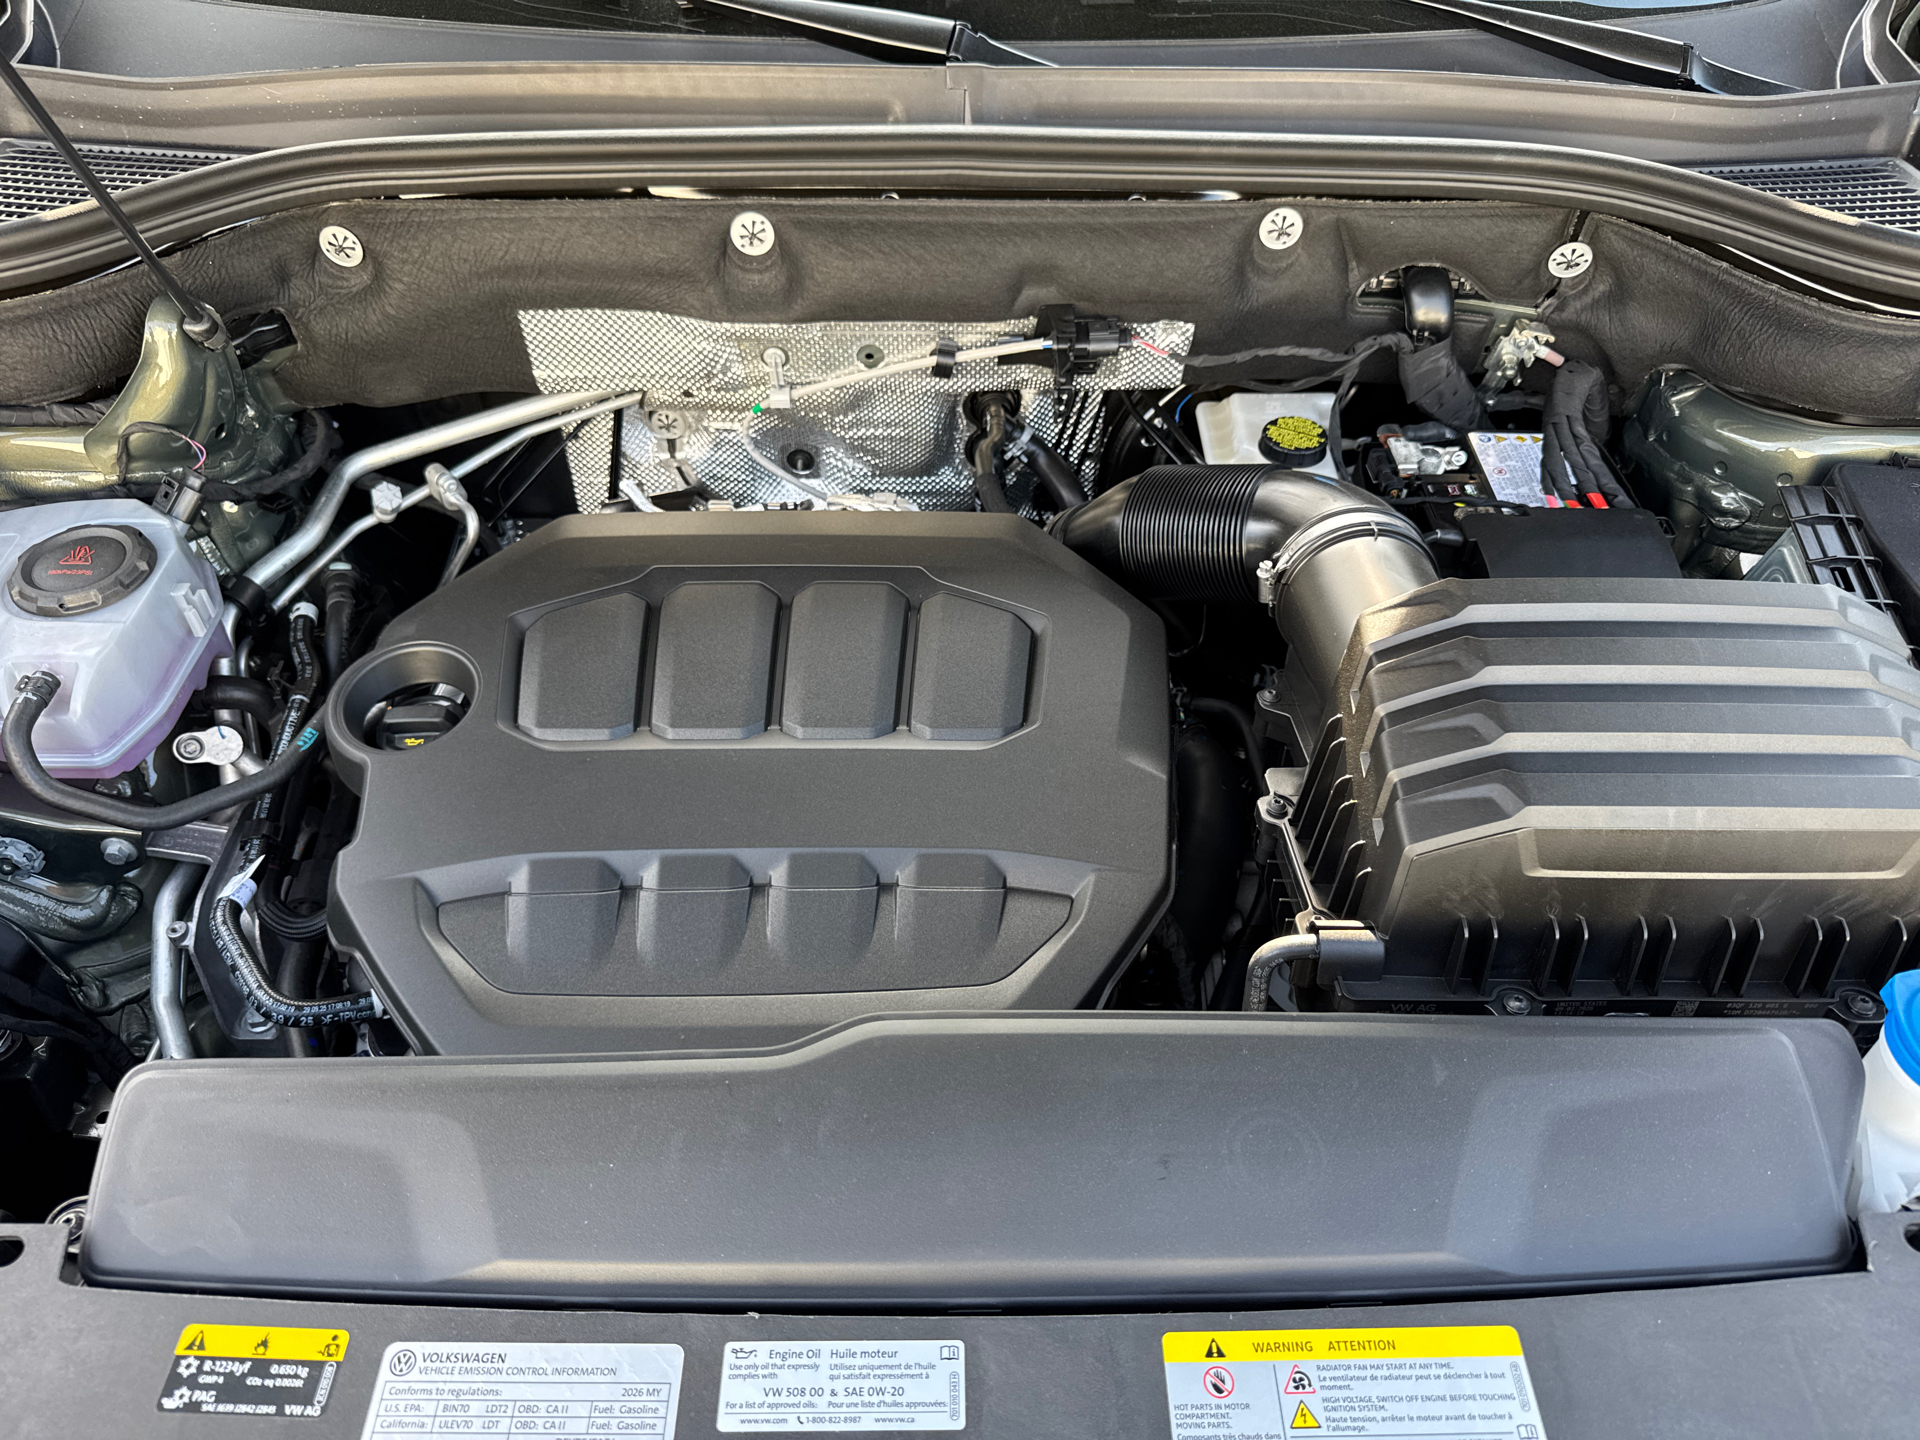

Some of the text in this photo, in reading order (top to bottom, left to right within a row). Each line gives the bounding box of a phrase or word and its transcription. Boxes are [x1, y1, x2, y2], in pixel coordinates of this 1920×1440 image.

[1391, 1003, 1437, 1012] VW AG
[271, 1013, 285, 1024] 39
[300, 1016, 314, 1026] 25
[1252, 1339, 1396, 1353] WARNING ATTENTION
[422, 1352, 507, 1364] VOLKSWAGEN
[768, 1349, 821, 1362] Engine Oil
[830, 1349, 898, 1359] Huile moteur
[202, 1360, 252, 1377] R-1234yf
[297, 1365, 310, 1379] kg
[419, 1366, 617, 1377] VEHICLE EMISSION CONTROL INFORMATION
[729, 1362, 820, 1372] Use only oil that expressly
[829, 1363, 857, 1371] Utilisez
[857, 1363, 902, 1372] uniquement
[1316, 1364, 1352, 1372] RADIATOR
[1354, 1363, 1368, 1371] FAN
[1369, 1363, 1384, 1371] MAY
[1385, 1363, 1407, 1371] START
[1418, 1362, 1433, 1370] ANY
[1434, 1362, 1454, 1370] TIME.
[728, 1372, 778, 1381] complies with
[828, 1371, 930, 1382] qui satisfait expressément à
[1317, 1374, 1327, 1382] Le
[1328, 1374, 1367, 1382] ventilateur
[1369, 1373, 1379, 1381] de
[1415, 1372, 1432, 1382] peut
[1443, 1372, 1482, 1380] déclencher
[1483, 1371, 1488, 1379] à
[191, 1389, 217, 1403] PAG
[388, 1386, 503, 1399] Conforms to regulations:
[621, 1387, 662, 1397] 2026 MY
[763, 1386, 905, 1397] VW 508 00 & SAE 0W-20
[1321, 1396, 1340, 1404] HIGH
[1341, 1396, 1376, 1404] VOLTAGE,
[1376, 1395, 1404, 1403] SWITCH
[1421, 1394, 1448, 1402] ENGINE
[1449, 1393, 1478, 1402] BEFORE
[1479, 1393, 1516, 1401] TOUCHING
[384, 1403, 424, 1413] U.S. EPA:
[442, 1404, 509, 1414] BIN70 LDT2
[517, 1404, 542, 1414] OBD:
[546, 1404, 559, 1414] CA
[725, 1401, 738, 1409] For
[745, 1401, 756, 1409] list
[757, 1401, 766, 1409] of
[766, 1401, 801, 1410] approved
[802, 1401, 818, 1409] oils:
[827, 1400, 845, 1408] Pour
[860, 1400, 876, 1408] liste
[876, 1399, 904, 1408] d'huiles
[905, 1399, 949, 1409] approuvées:
[1174, 1403, 1189, 1411] HOT
[1190, 1403, 1213, 1411] PARTS
[1214, 1403, 1223, 1411] IN
[1357, 1404, 1388, 1412] SYSTEM.
[284, 1404, 321, 1417] VW AG
[593, 1404, 660, 1415] Fuel: Gasoline
[806, 1416, 862, 1424] 1-800-822-8987
[1174, 1412, 1232, 1420] COMPARTMENT.
[1325, 1415, 1348, 1423] Haute
[1349, 1415, 1380, 1424] tension,
[1380, 1414, 1406, 1422] arrêter
[1407, 1414, 1415, 1422] le
[1416, 1413, 1443, 1421] moteur
[1444, 1413, 1466, 1421] avant
[1478, 1412, 1506, 1420] toucher
[1507, 1412, 1513, 1420] à
[380, 1419, 429, 1429] California:
[438, 1420, 501, 1430] ULEV70 LDT
[514, 1420, 539, 1430] OBD:
[543, 1420, 557, 1430] CA
[590, 1420, 657, 1431] Fuel: Gasoline
[1175, 1421, 1233, 1430] MOVING PARTS.
[1326, 1424, 1369, 1433] l'allumage.
[1237, 1432, 1263, 1440] chauds
[1264, 1432, 1282, 1440] dans
